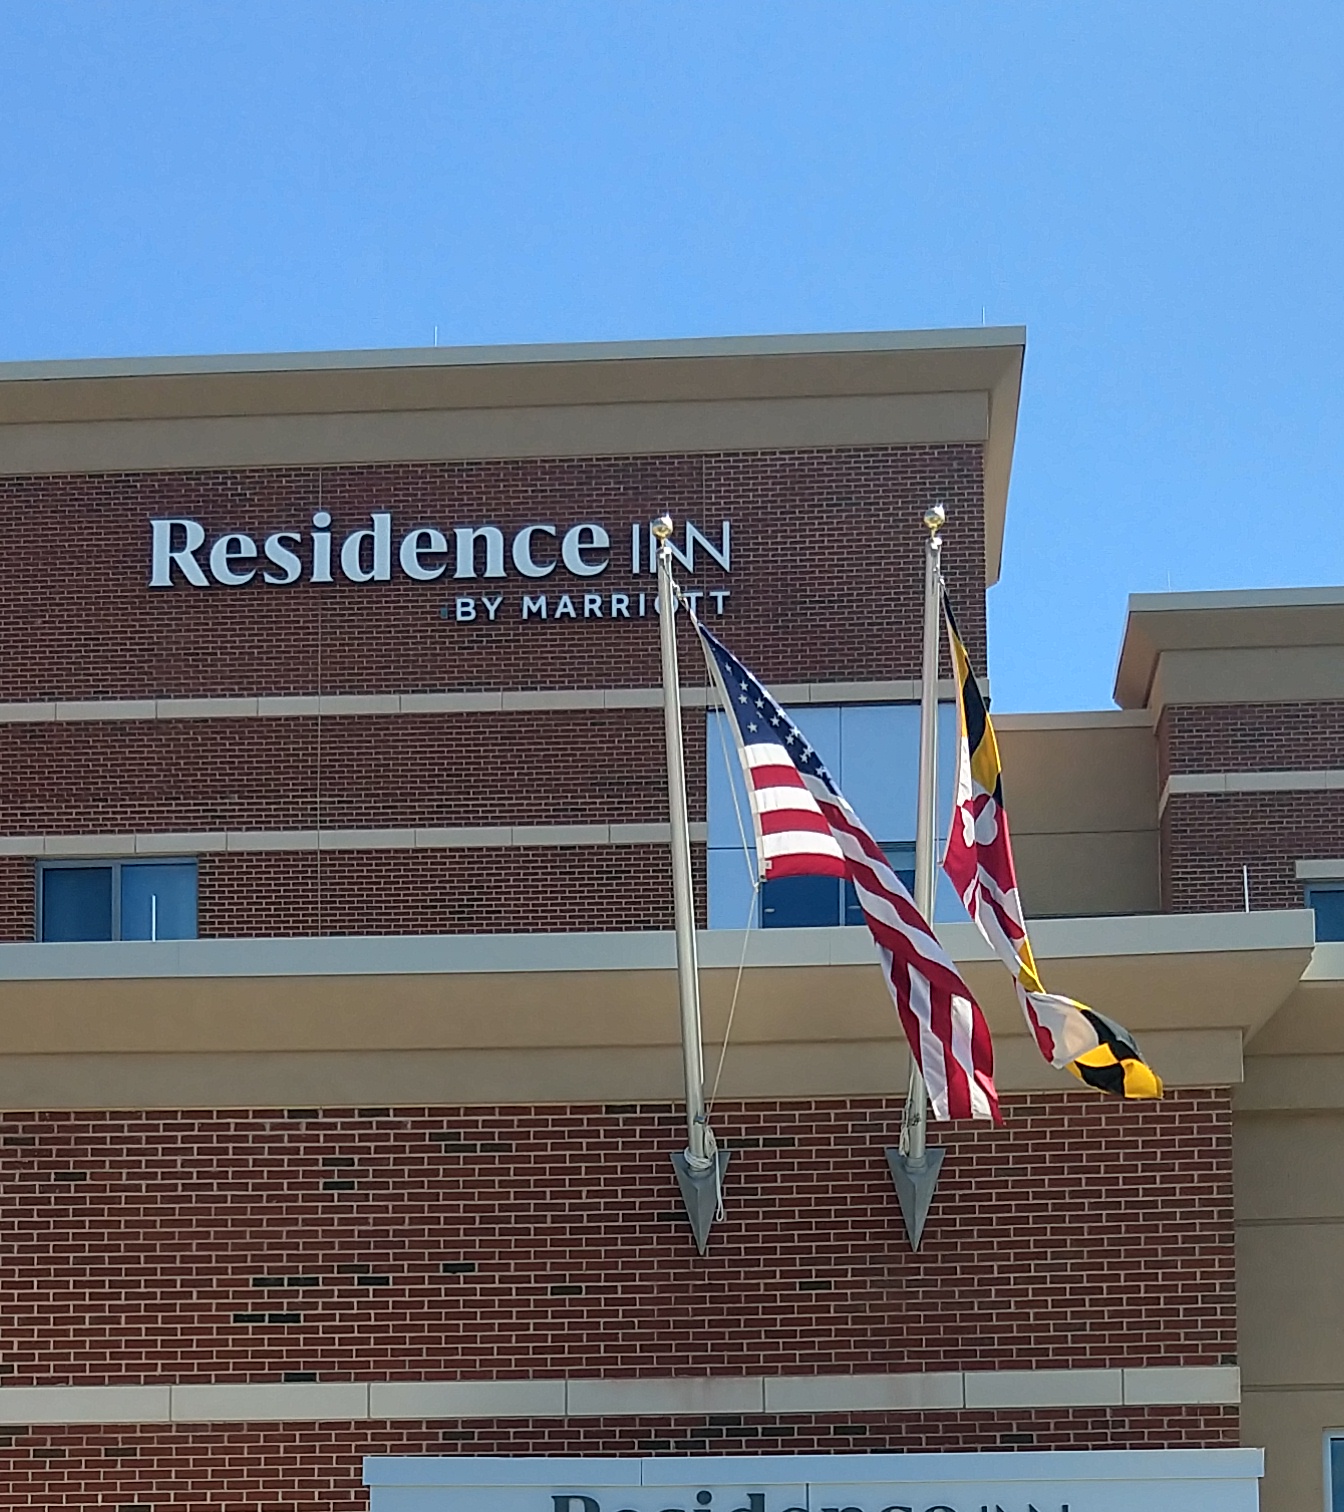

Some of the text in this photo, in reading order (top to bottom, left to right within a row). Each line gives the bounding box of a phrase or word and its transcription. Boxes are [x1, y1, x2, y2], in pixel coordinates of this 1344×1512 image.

[148, 511, 731, 587] Residence INN
[456, 595, 503, 622] BY
